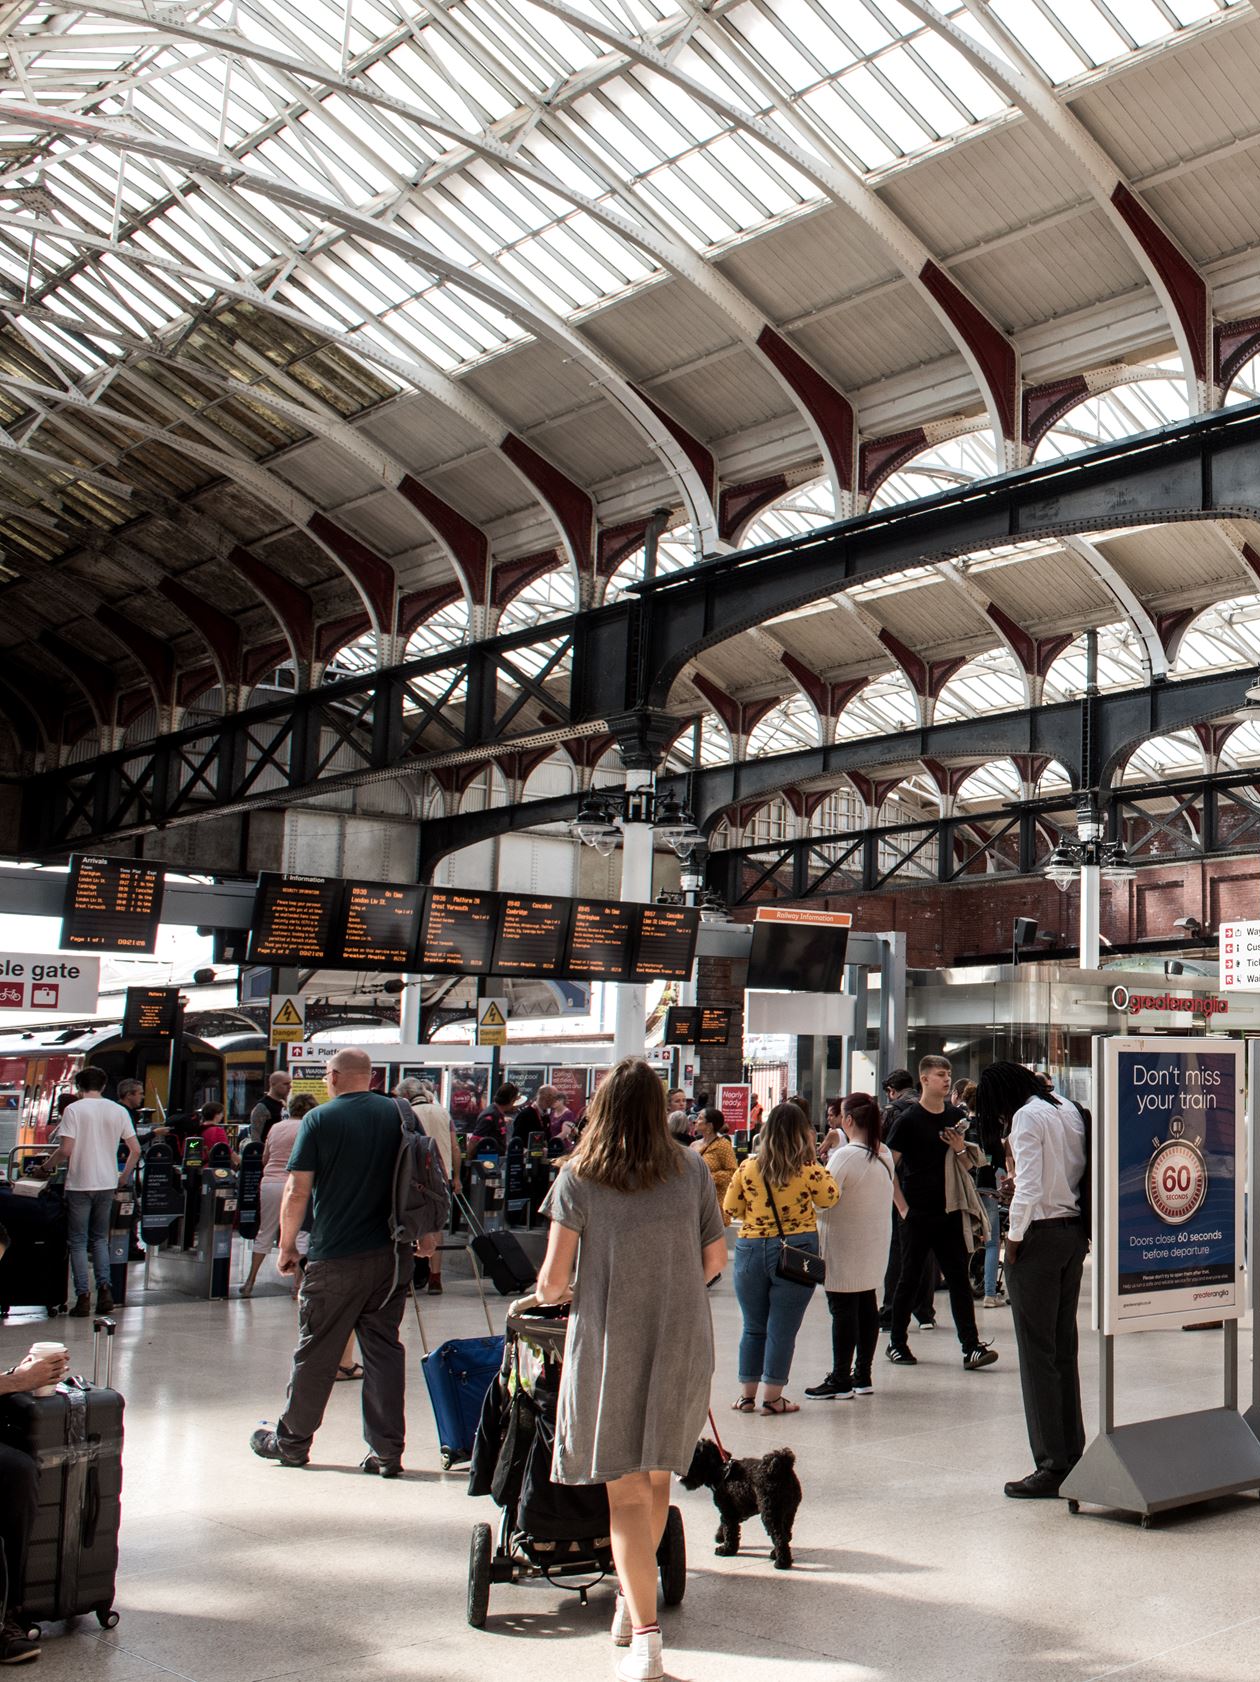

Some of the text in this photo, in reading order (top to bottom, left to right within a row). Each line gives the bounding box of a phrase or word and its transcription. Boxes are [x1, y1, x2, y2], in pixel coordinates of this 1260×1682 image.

[82, 857, 108, 865] Arrivals
[290, 875, 325, 883] Information
[777, 912, 834, 921] Railway Information
[32, 963, 80, 981] gate
[1129, 992, 1228, 1018] greateranglia
[273, 1029, 298, 1037] Danger
[1133, 1065, 1222, 1086] Don't miss
[723, 1091, 744, 1099] Nearly
[723, 1100, 741, 1108] ready.
[1137, 1090, 1217, 1115] your train
[1162, 1165, 1192, 1193] 60
[1166, 1193, 1189, 1201] SECONDS
[1130, 1230, 1222, 1247] Doors close 60 seconds
[1143, 1246, 1210, 1260] before departure
[1192, 1289, 1229, 1301] greateranglia
